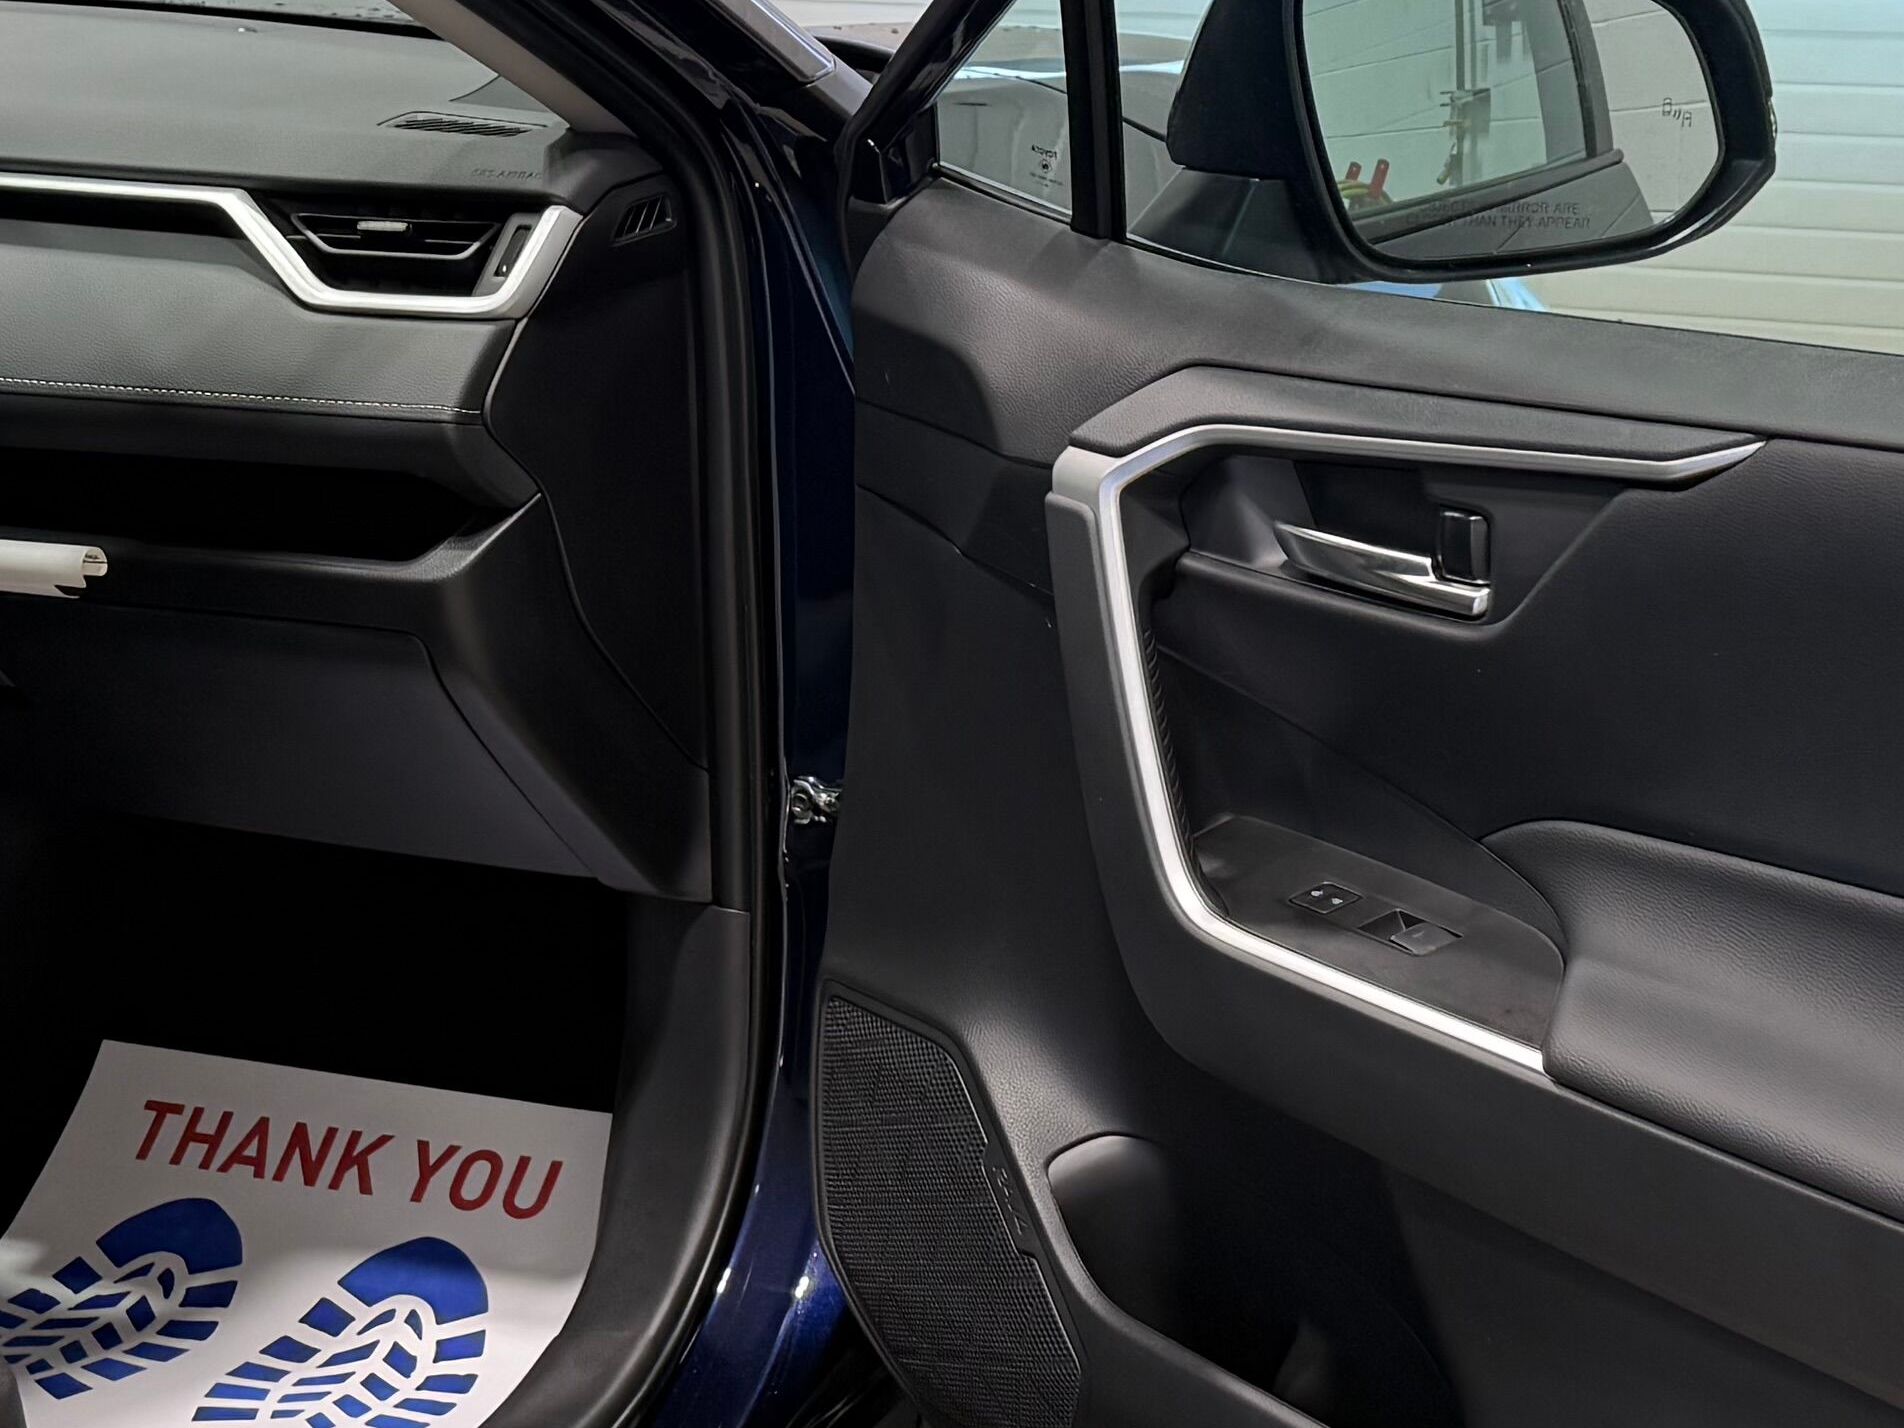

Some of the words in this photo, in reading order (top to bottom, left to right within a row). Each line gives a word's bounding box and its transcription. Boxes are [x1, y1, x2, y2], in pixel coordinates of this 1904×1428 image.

[1552, 201, 1581, 216] ARE
[135, 1099, 395, 1196] THANK
[409, 1139, 564, 1220] YOU
